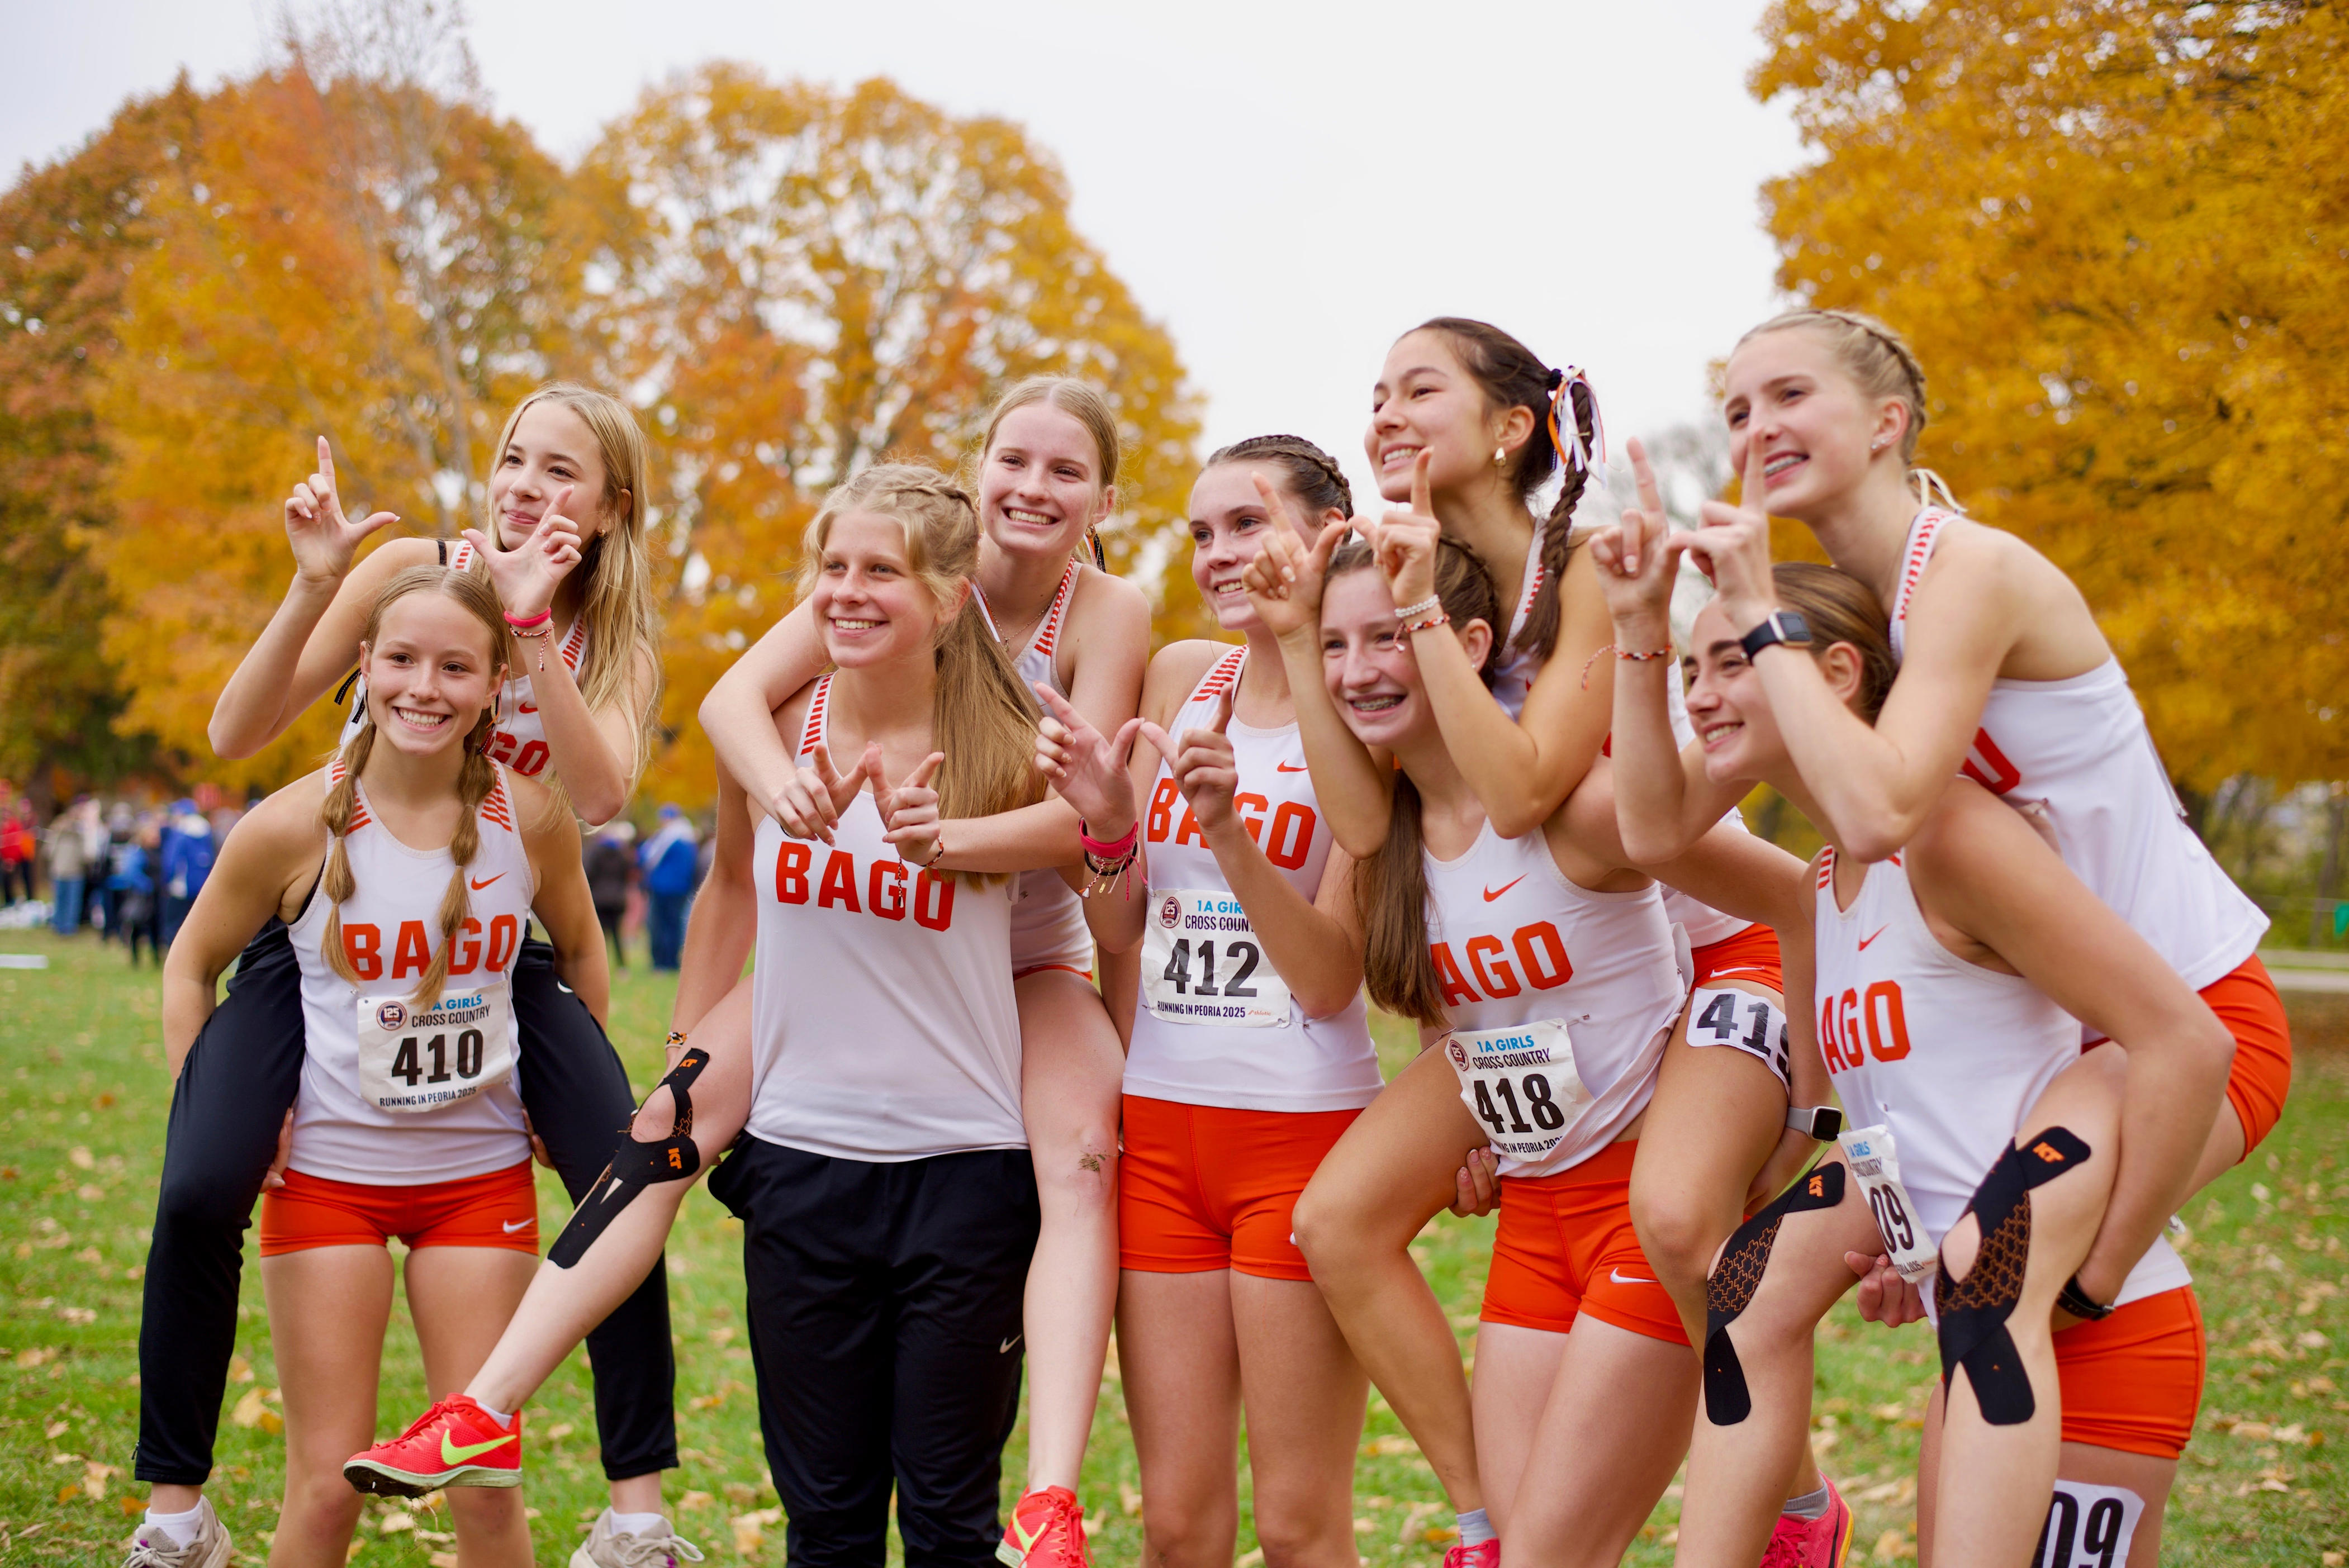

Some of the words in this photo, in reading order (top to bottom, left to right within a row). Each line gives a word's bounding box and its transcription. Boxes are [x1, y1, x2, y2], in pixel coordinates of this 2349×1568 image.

[481, 731, 550, 776] GO
[776, 842, 955, 932] BAGO
[1197, 900, 1213, 913] 1A
[1217, 901, 1243, 914] GIR
[1185, 915, 1216, 930] CROSS
[1219, 917, 1254, 932] COUN
[342, 914, 517, 981] BAGO
[1164, 938, 1259, 997] 412
[1430, 920, 1574, 1007] AGO
[383, 1008, 400, 1019] 125
[428, 1001, 443, 1011] A
[446, 994, 482, 1010] GIRLS
[1157, 1001, 1184, 1014] RUNNING
[1185, 1004, 1193, 1015] IN
[1194, 1005, 1221, 1017] PEORIA
[1223, 1006, 1245, 1018] 2025
[412, 1013, 445, 1028] CROSS
[449, 1004, 491, 1024] COUNTRY
[1821, 980, 1911, 1074] AGO
[1477, 1040, 1494, 1053] 1A
[1496, 1035, 1534, 1051] GIRLS
[392, 1029, 483, 1087] 410
[1473, 1056, 1504, 1070] CROSS
[1503, 1048, 1551, 1067] COUNTRY
[379, 1095, 416, 1107] RUNNING
[418, 1094, 426, 1104] IN
[428, 1090, 456, 1103] PEORIA
[457, 1086, 477, 1098] 2025
[1474, 1073, 1564, 1134] 418
[668, 1147, 682, 1170] KT
[1509, 1143, 1517, 1153] IN
[1517, 1142, 1545, 1153] PEORIA
[2033, 1142, 2065, 1163] KT
[1809, 1175, 1824, 1198] KT
[1869, 1184, 1914, 1254] 09
[2030, 1491, 2124, 1568] 09
